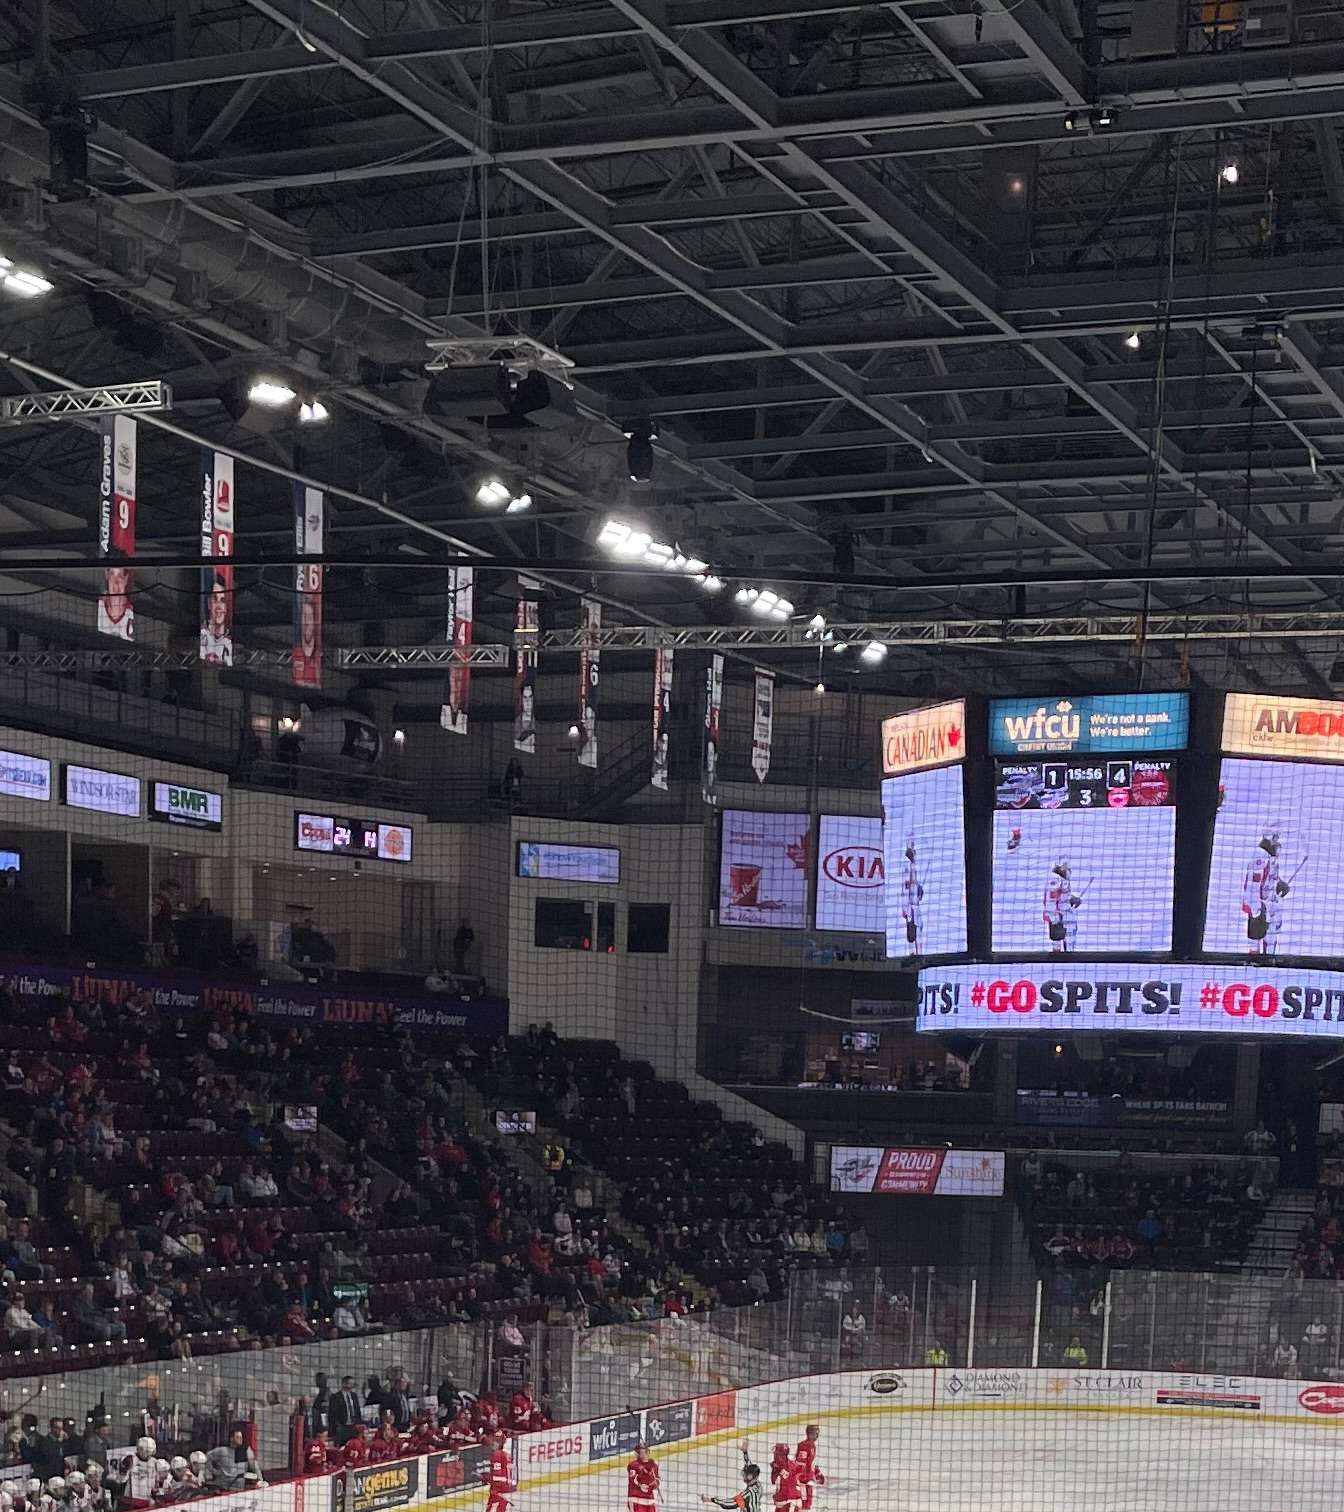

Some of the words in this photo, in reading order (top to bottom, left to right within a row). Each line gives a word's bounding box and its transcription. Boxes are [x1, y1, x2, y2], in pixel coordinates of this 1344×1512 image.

[100, 435, 112, 497] Graves
[119, 500, 129, 529] 9
[100, 501, 111, 552] Adam
[218, 534, 229, 557] 9
[1005, 704, 1080, 740] wfcu
[1090, 715, 1117, 725] We're
[1119, 715, 1134, 724] not
[1090, 727, 1118, 737] We're
[887, 730, 945, 767] CANADIAN
[1002, 767, 1039, 776] PENALTY
[1067, 768, 1103, 781] 15:56
[1134, 761, 1171, 771] PENALTY
[1049, 770, 1057, 786] 1
[1113, 769, 1126, 784] 4
[168, 787, 209, 814] BMR
[1079, 789, 1093, 806] 3
[836, 855, 885, 879] KIA
[887, 1151, 937, 1169] PROUD
[528, 1436, 584, 1463] FREEDS
